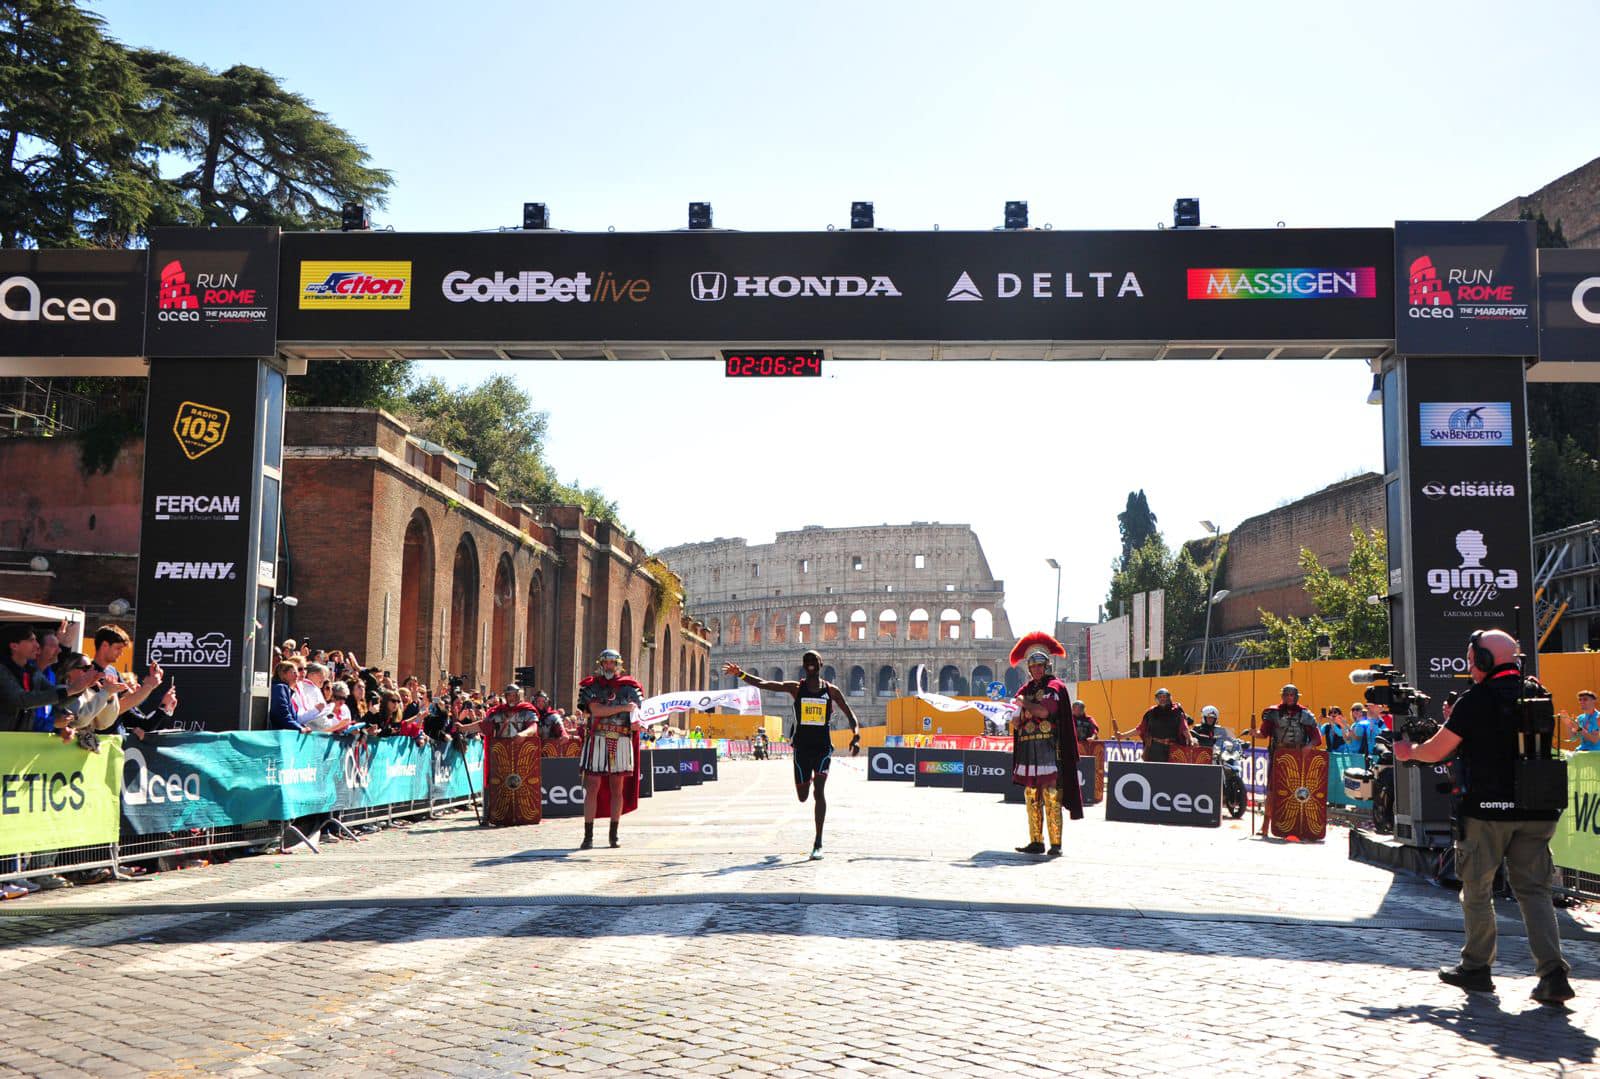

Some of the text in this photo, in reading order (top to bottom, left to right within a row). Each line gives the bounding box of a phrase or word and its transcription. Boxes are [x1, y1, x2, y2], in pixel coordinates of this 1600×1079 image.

[196, 273, 239, 289] RUN
[318, 271, 405, 295] Action
[997, 271, 1145, 298] DELTA
[1205, 271, 1358, 294] MASSIGEN
[1448, 268, 1493, 285] RUN
[733, 275, 903, 297] HONDA
[1457, 285, 1515, 301] ROME
[203, 289, 257, 305] ROME
[158, 310, 200, 322] acea
[218, 309, 267, 319] MARATHON
[1408, 306, 1455, 319] acea
[1474, 307, 1528, 316] MARATHON
[726, 356, 820, 376] 02:06:24
[191, 408, 218, 421] RADIO
[180, 415, 222, 443] 105
[1430, 428, 1503, 440] SAN BENEDETTO
[155, 495, 240, 513] FERCAM
[1427, 568, 1519, 594] gima
[151, 632, 195, 649] ADR
[150, 649, 228, 663] e-move
[1430, 657, 1469, 671] SPO
[871, 752, 915, 774] ace
[1114, 773, 1214, 814] acea
